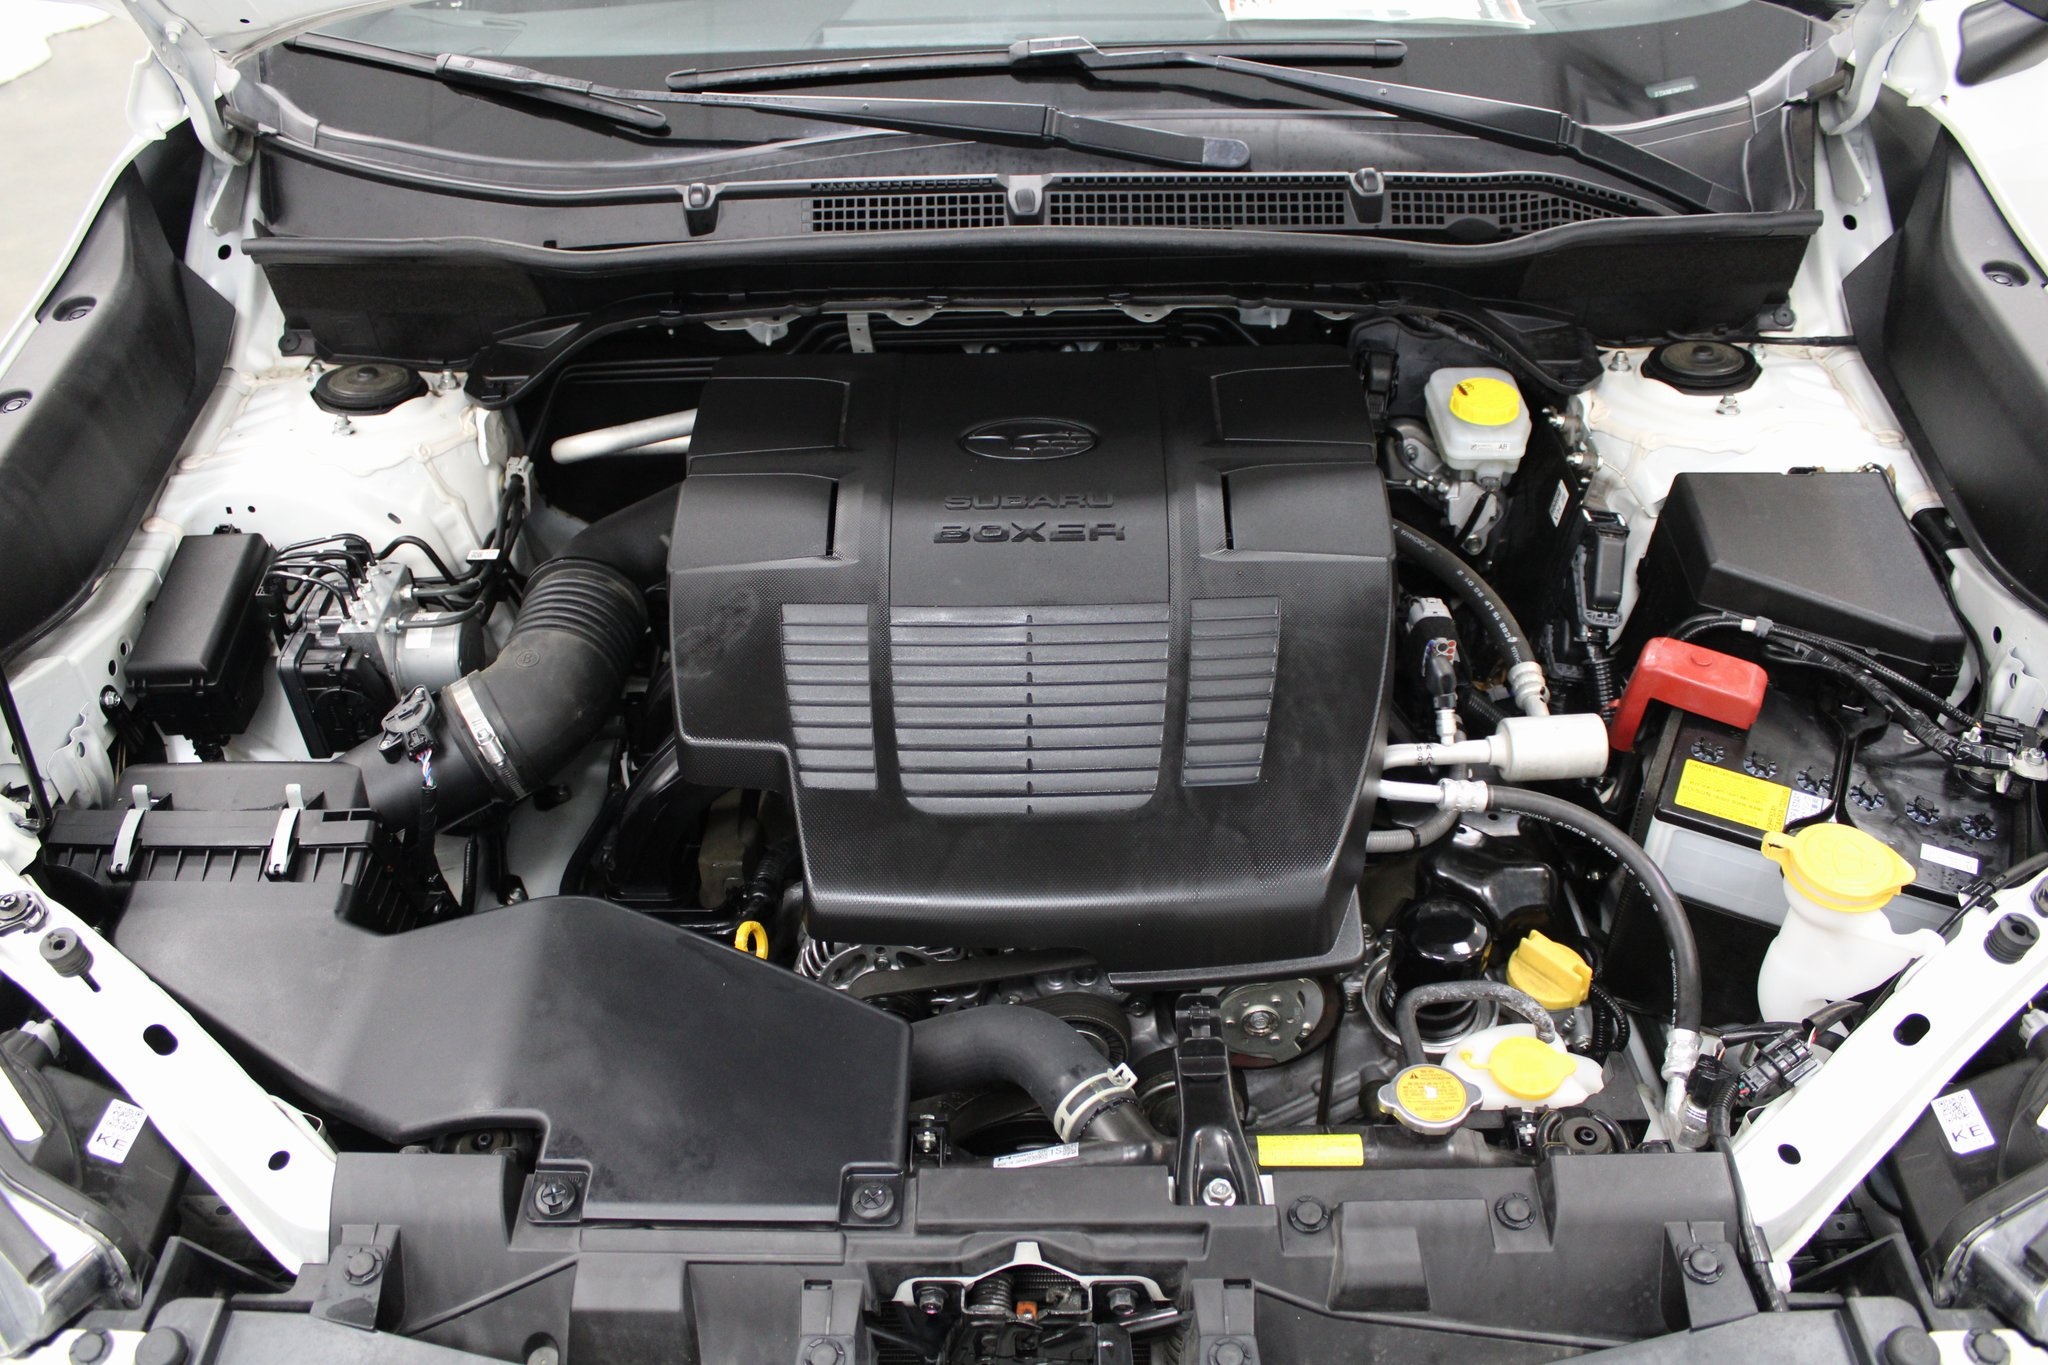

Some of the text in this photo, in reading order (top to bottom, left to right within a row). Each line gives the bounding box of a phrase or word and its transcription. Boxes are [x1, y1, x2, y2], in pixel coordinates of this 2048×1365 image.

[944, 494, 1114, 510] SUBARU
[934, 521, 1126, 544] BOXER
[96, 1132, 128, 1152] KE
[1951, 1124, 1985, 1142] KE
